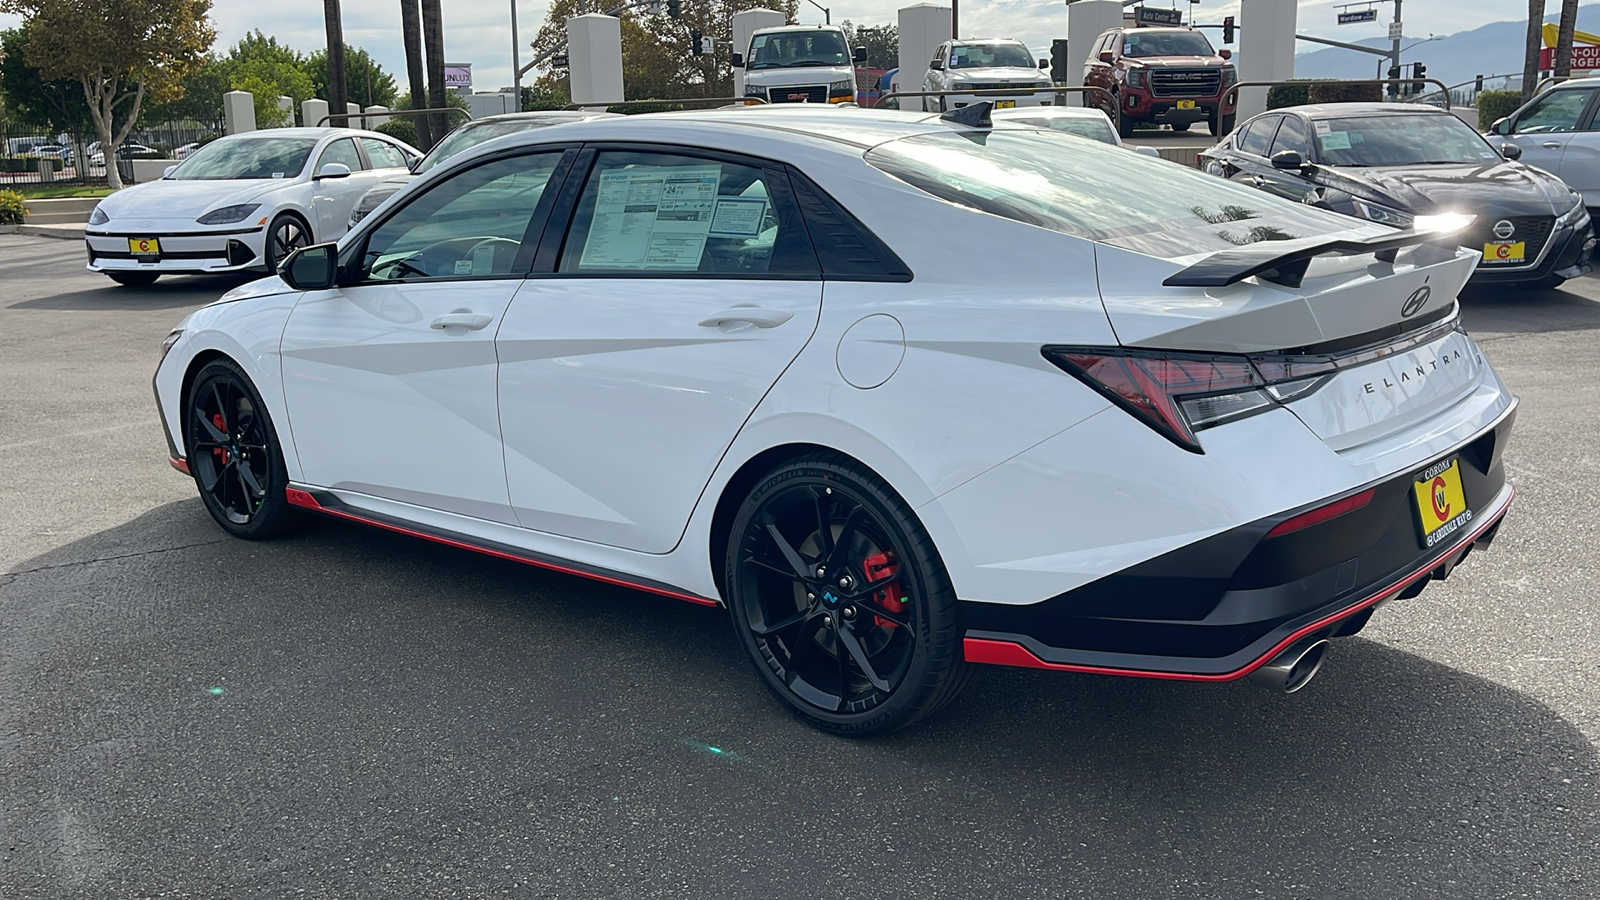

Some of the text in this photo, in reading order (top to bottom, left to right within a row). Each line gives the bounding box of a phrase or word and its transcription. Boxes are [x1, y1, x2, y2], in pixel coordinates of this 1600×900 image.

[667, 186, 676, 194] 24
[1364, 350, 1461, 394] ELANTRA
[762, 469, 804, 492] MICHELIN
[1424, 460, 1451, 480] CORONA
[1431, 476, 1450, 522] C
[1436, 491, 1445, 509] W
[1433, 513, 1467, 543] CARDINALE WAY
